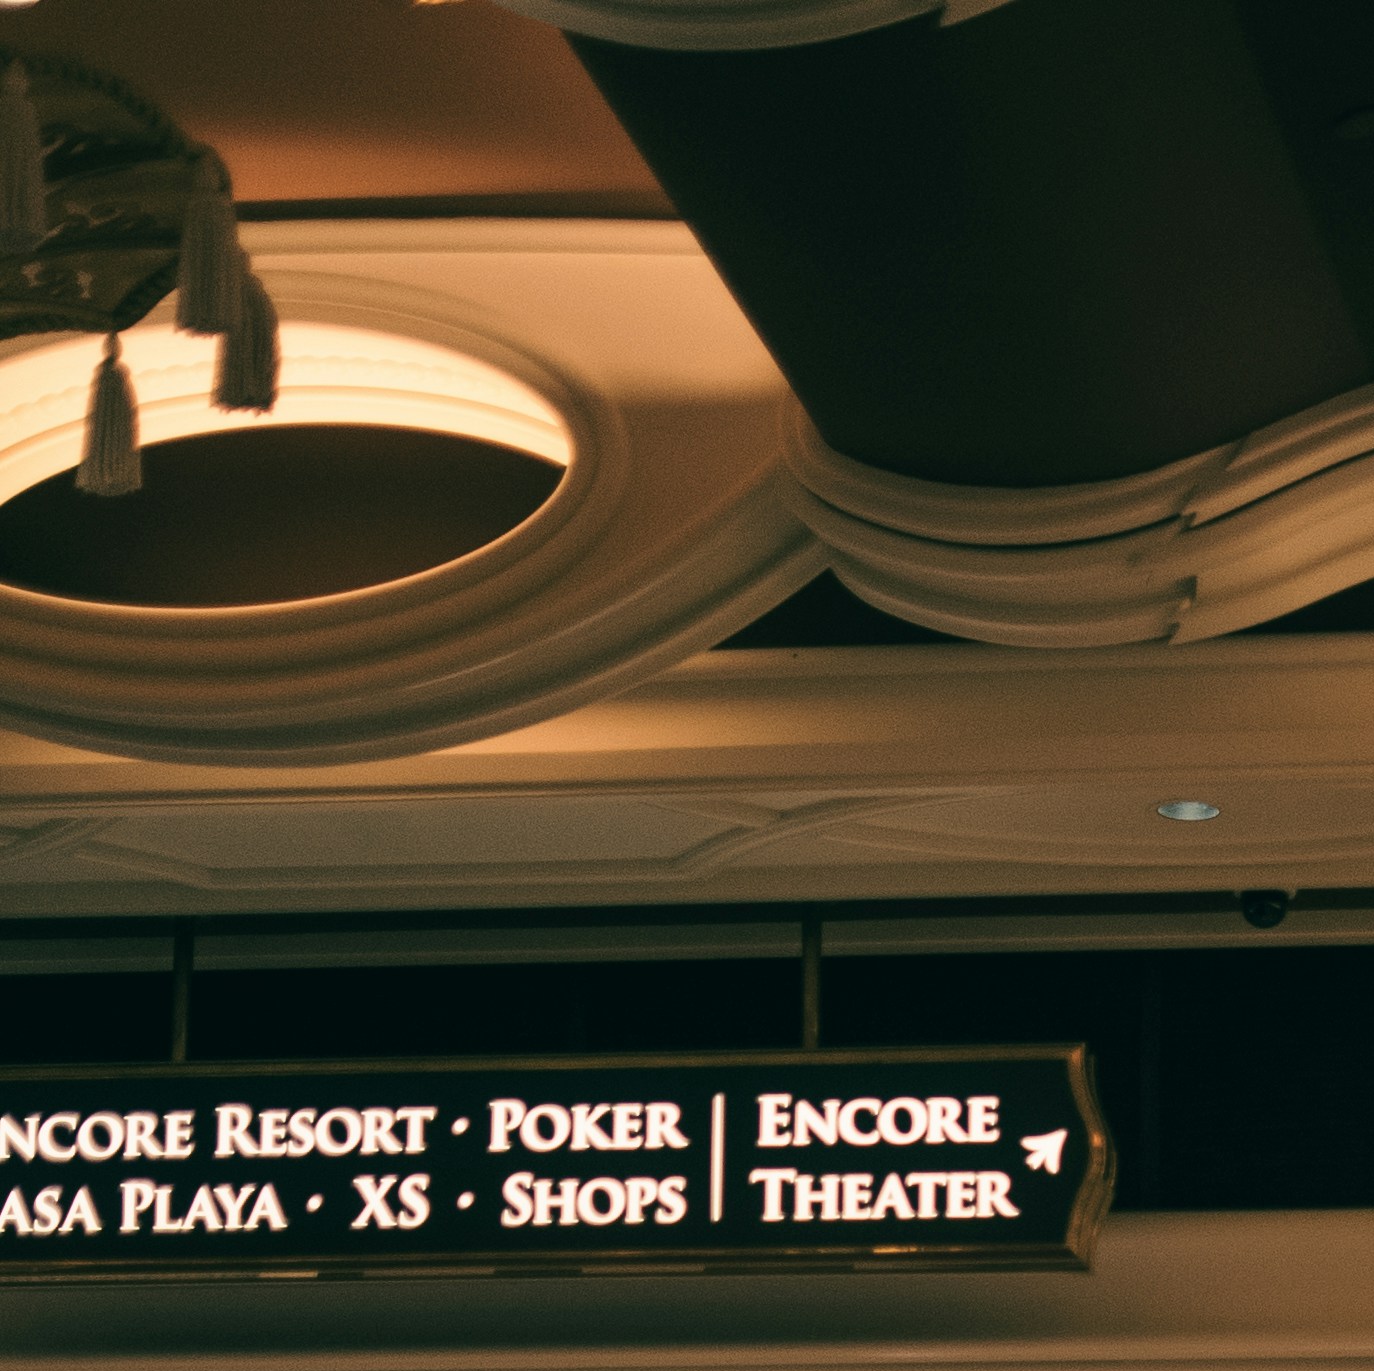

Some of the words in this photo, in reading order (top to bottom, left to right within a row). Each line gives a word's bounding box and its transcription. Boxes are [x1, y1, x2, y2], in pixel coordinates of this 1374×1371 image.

[214, 1103, 438, 1158] RESORT
[487, 1098, 690, 1152] POKER
[756, 1093, 1001, 1147] ENCORE
[119, 1178, 289, 1234] PLAYA
[350, 1173, 431, 1229] XS
[500, 1171, 688, 1227] SHOPS
[748, 1167, 1021, 1222] THEATER
